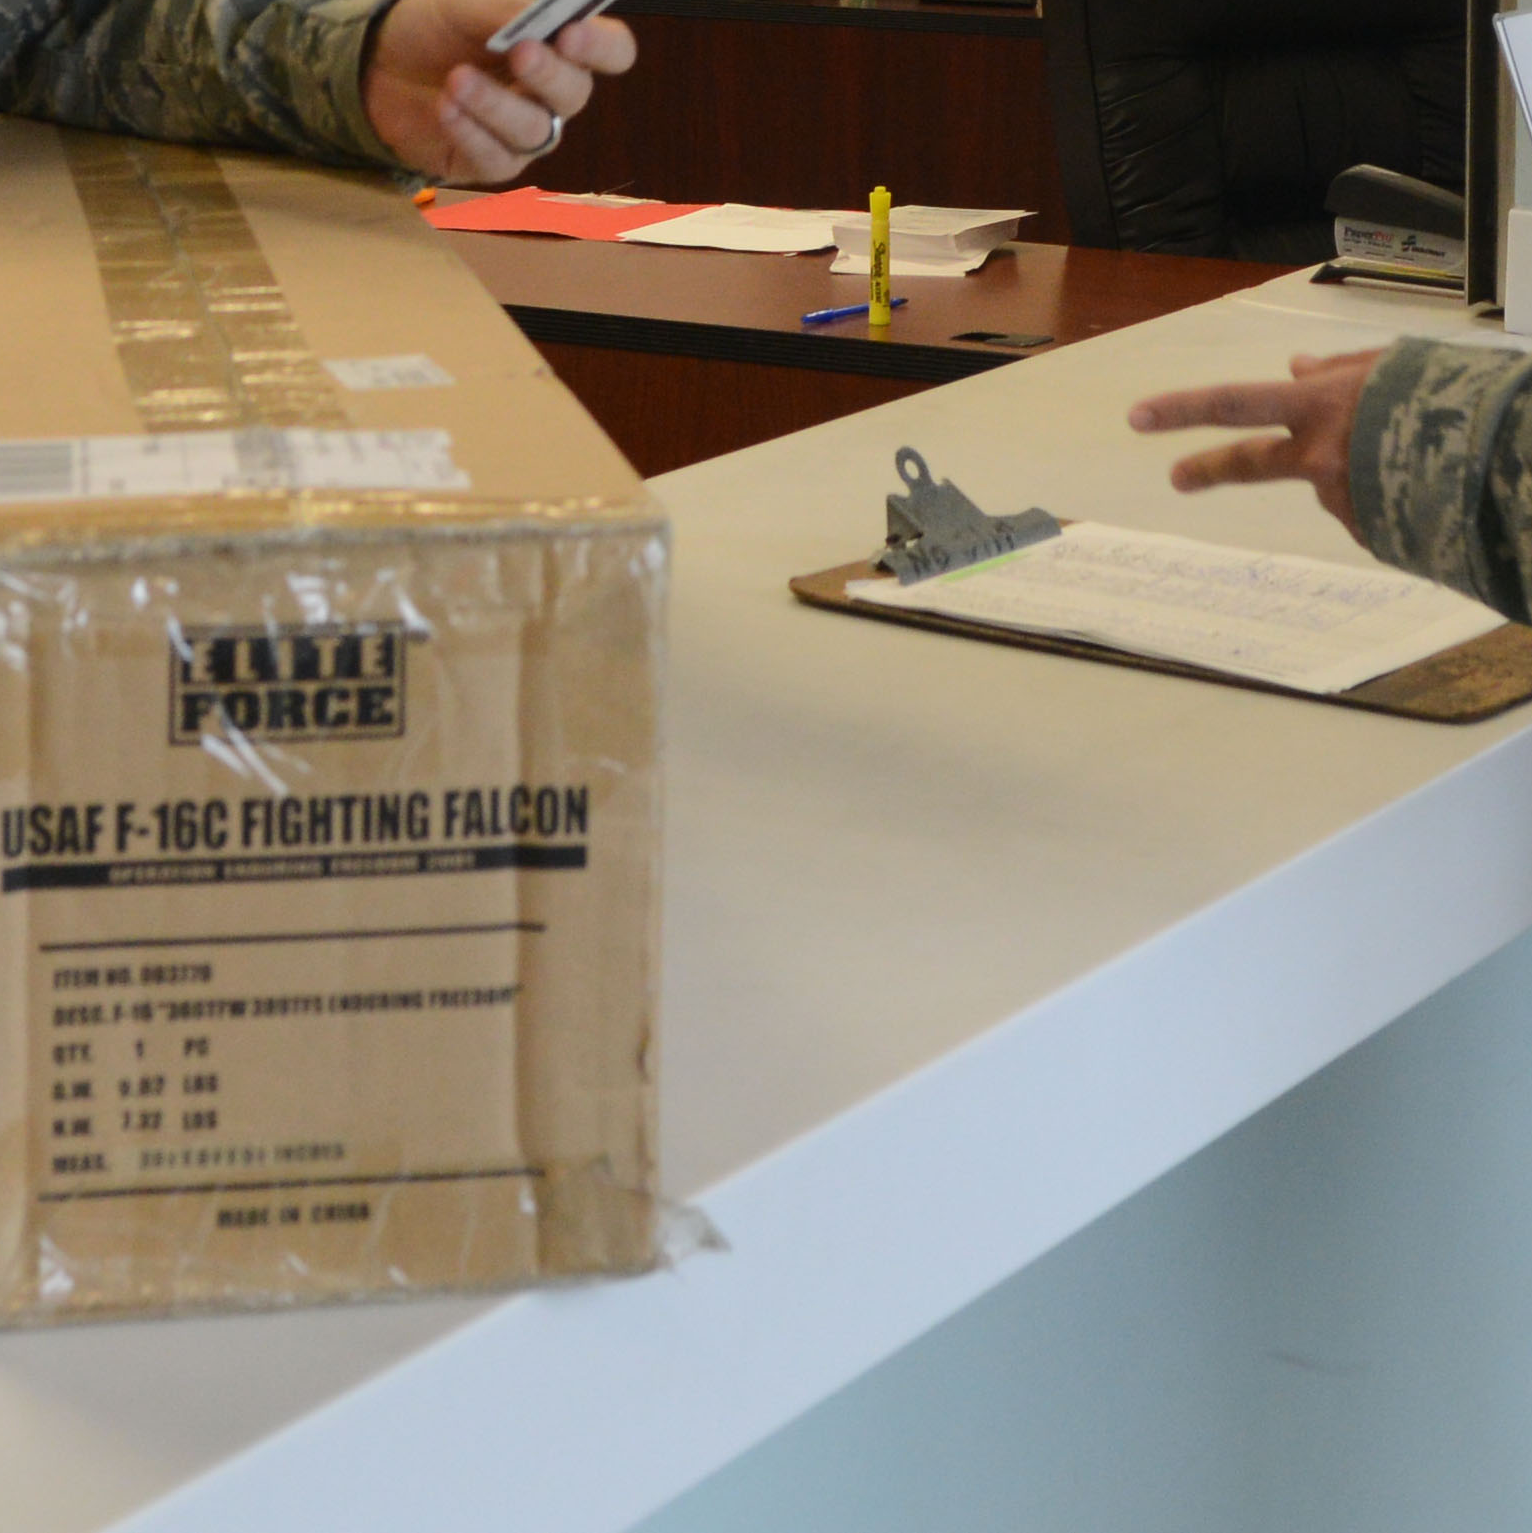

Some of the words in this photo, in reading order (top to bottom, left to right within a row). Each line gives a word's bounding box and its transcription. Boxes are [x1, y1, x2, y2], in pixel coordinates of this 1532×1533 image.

[181, 686, 394, 731] FORCE
[1, 804, 103, 857] USAF
[115, 799, 228, 852] F-16C
[241, 791, 430, 847] FIGHTING
[443, 785, 588, 838] FALCON
